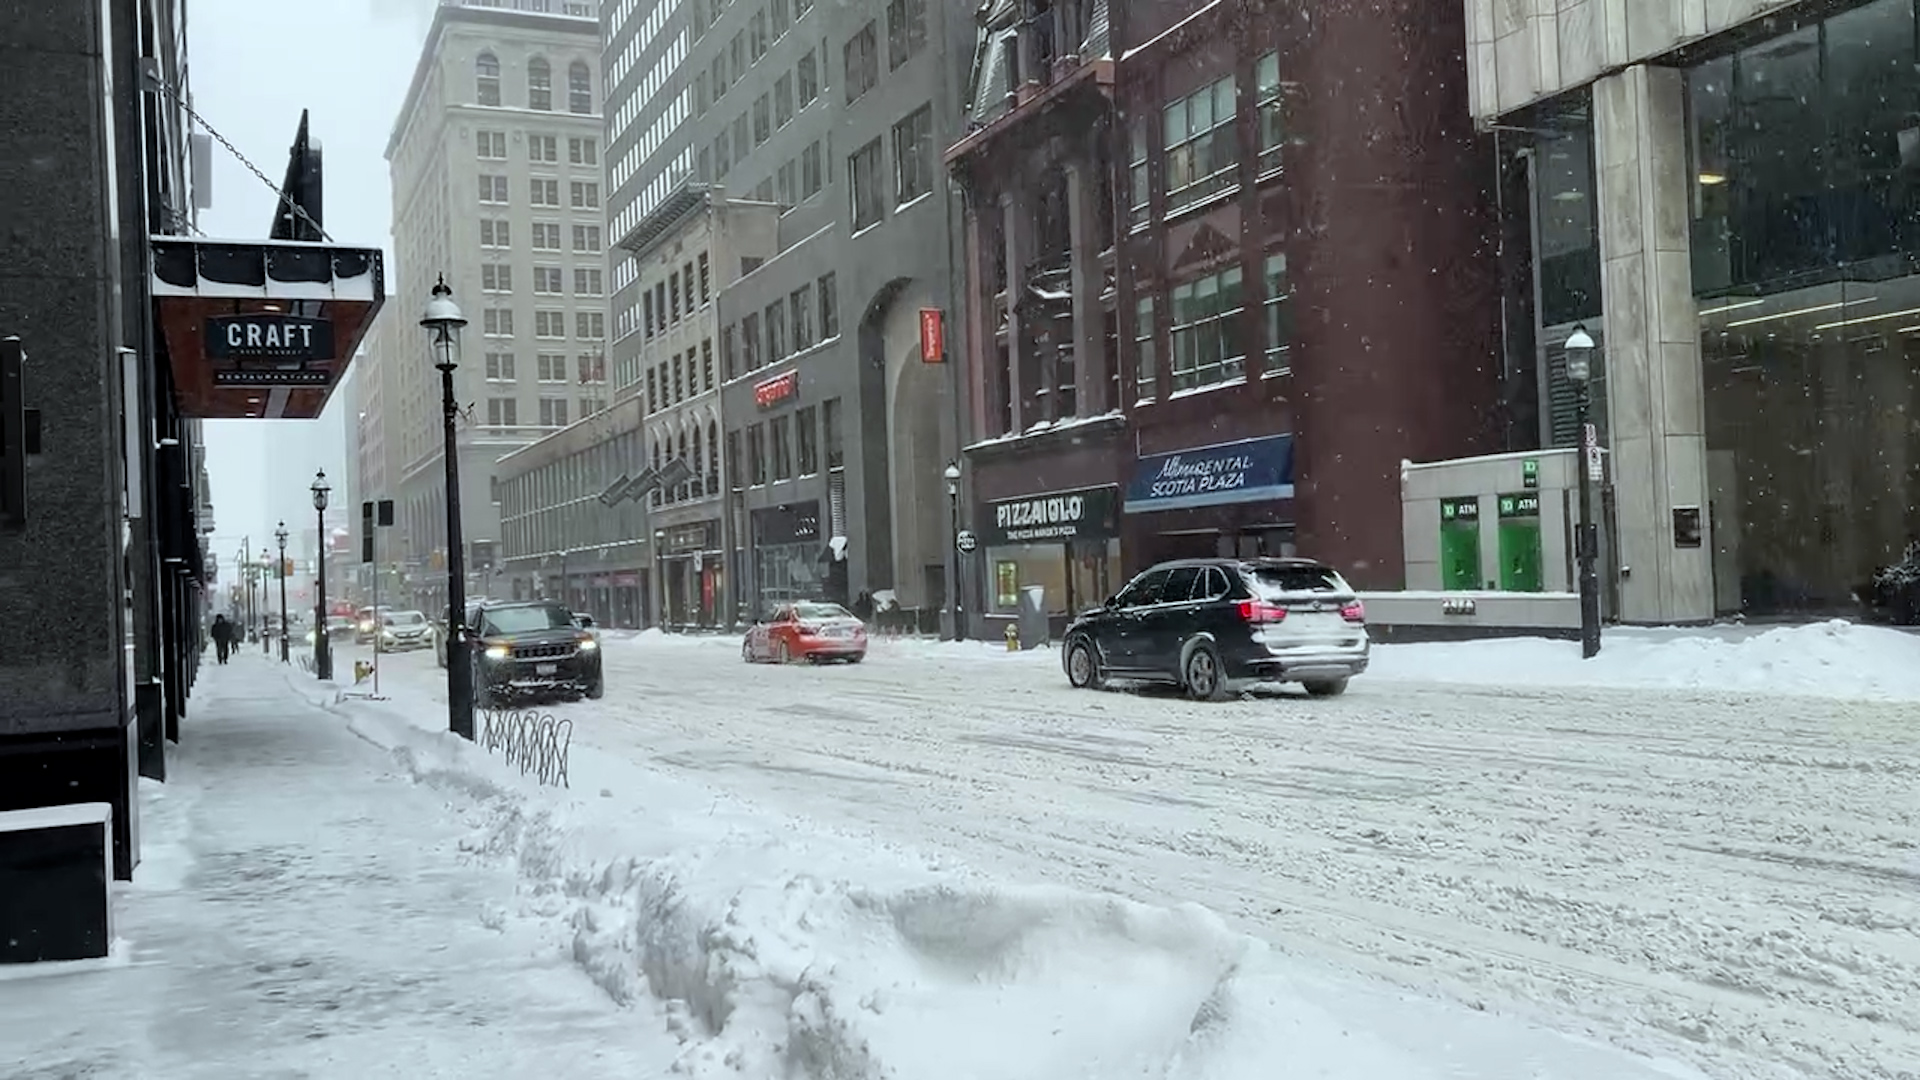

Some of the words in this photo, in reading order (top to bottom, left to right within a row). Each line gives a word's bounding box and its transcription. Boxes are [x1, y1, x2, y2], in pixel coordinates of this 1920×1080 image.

[227, 323, 312, 347] CRAFT
[1150, 477, 1195, 497] SCOTIA
[1198, 472, 1245, 491] PLAZA
[997, 496, 1082, 527] PIZZAIOLO
[1459, 504, 1477, 514] ATM
[1519, 499, 1538, 509] ATM
